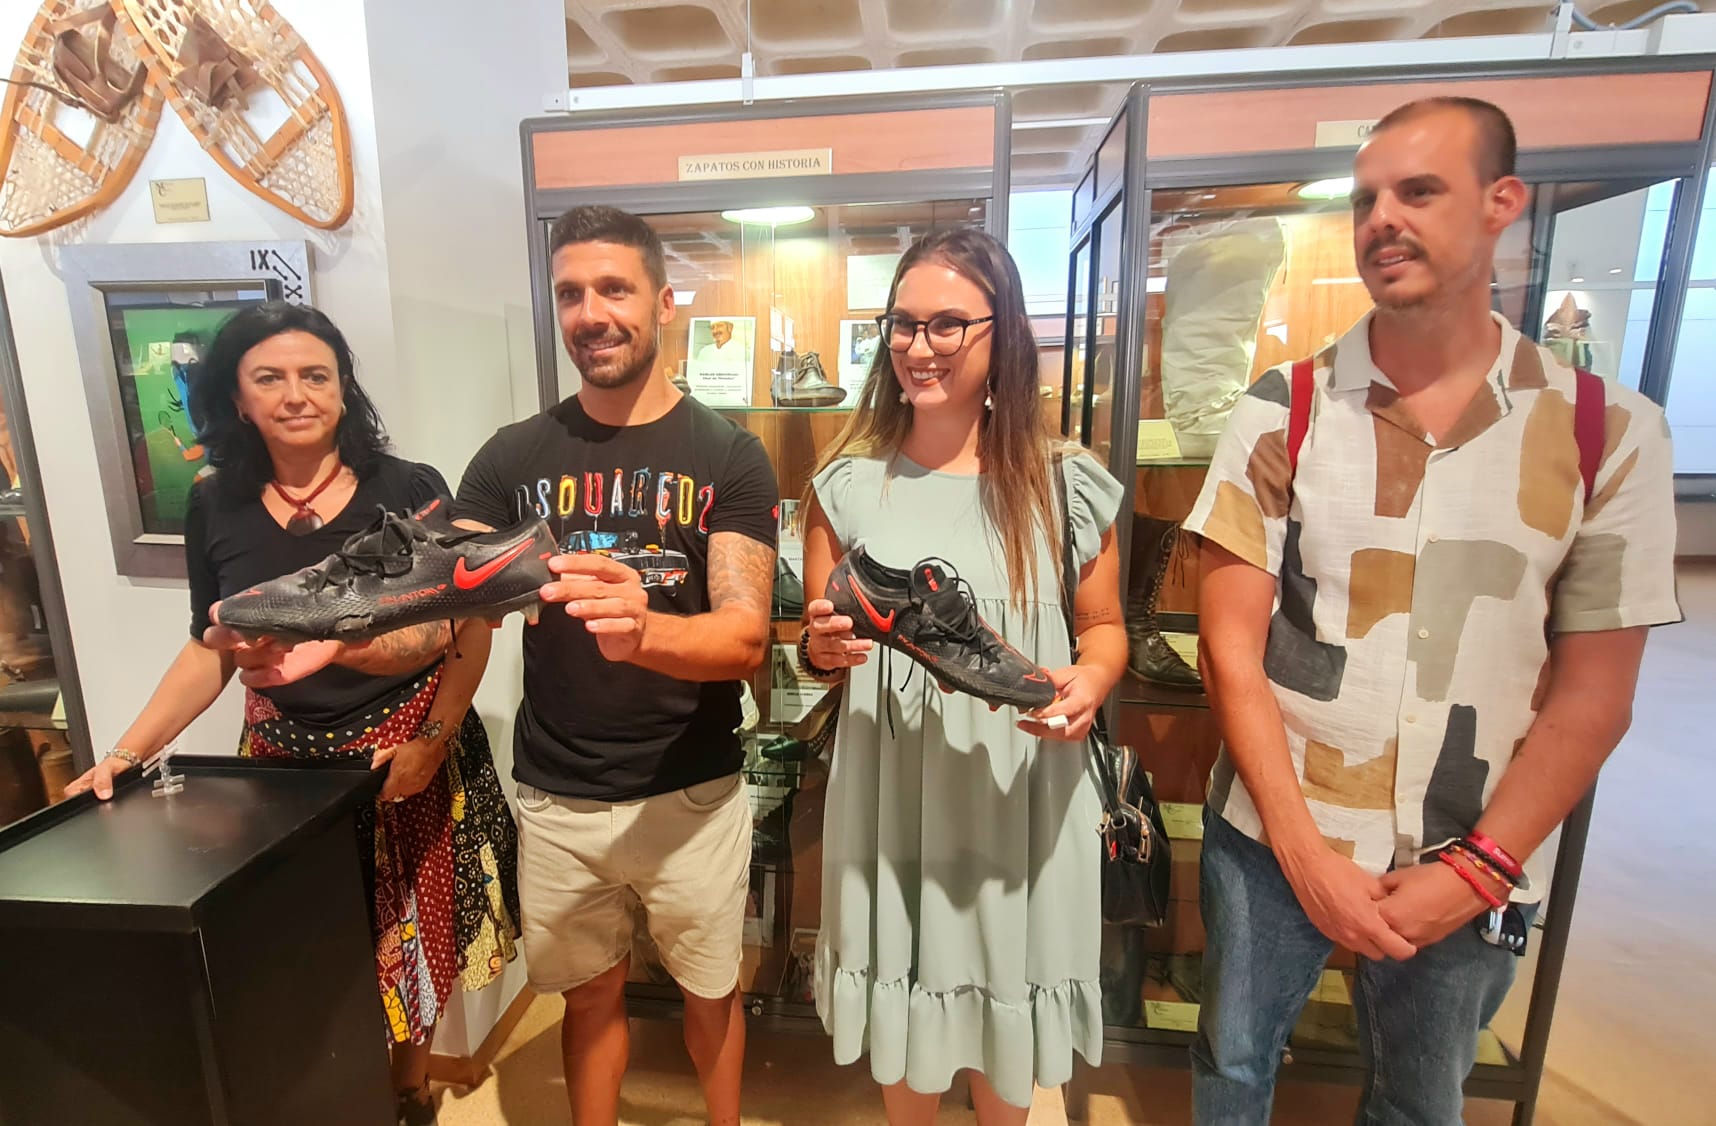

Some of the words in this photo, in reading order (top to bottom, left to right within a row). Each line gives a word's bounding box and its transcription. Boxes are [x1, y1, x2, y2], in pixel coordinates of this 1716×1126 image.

[686, 160, 740, 173] ZAPATOS
[743, 159, 765, 171] CON
[768, 157, 821, 170] HISTORIA
